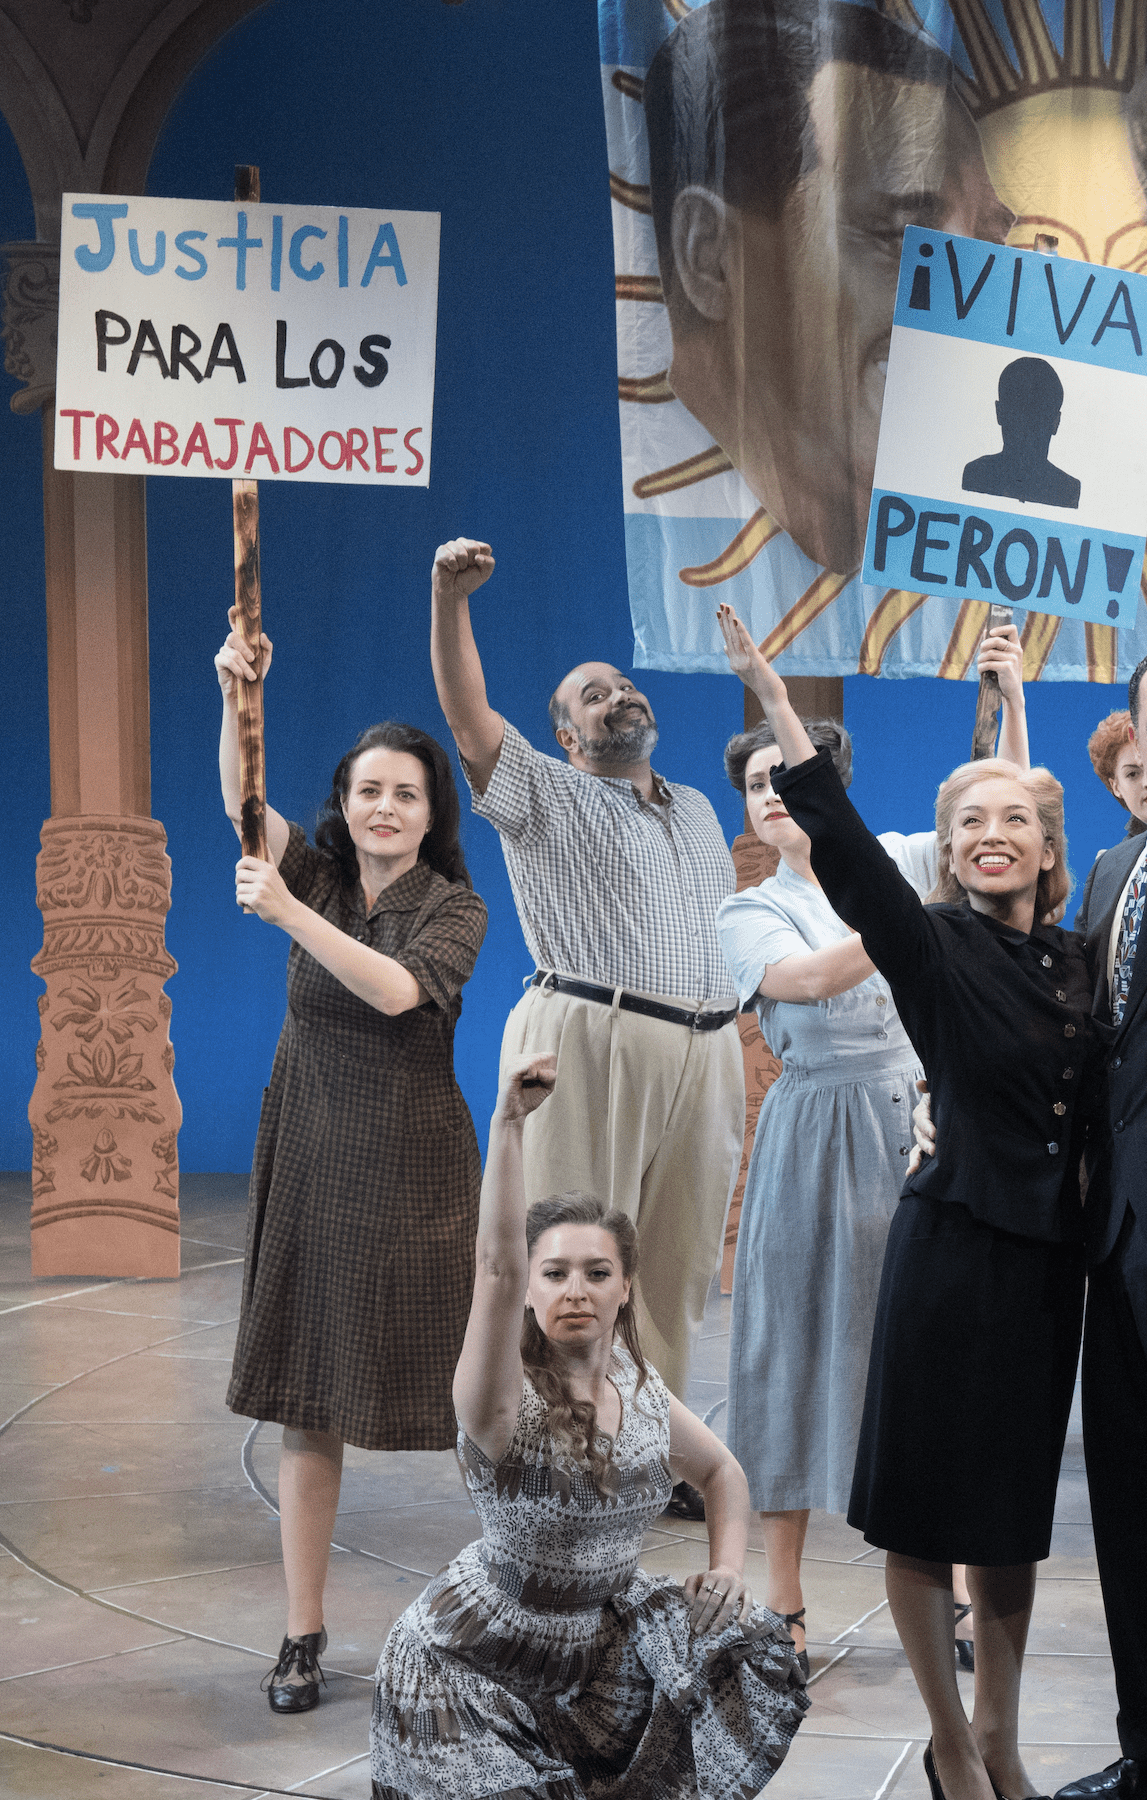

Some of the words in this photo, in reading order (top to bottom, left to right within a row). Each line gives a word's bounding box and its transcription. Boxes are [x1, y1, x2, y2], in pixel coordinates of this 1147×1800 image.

[95, 309, 246, 383] PARA
[60, 409, 424, 476] TRABAJADORES
[873, 495, 1135, 619] PERON!
